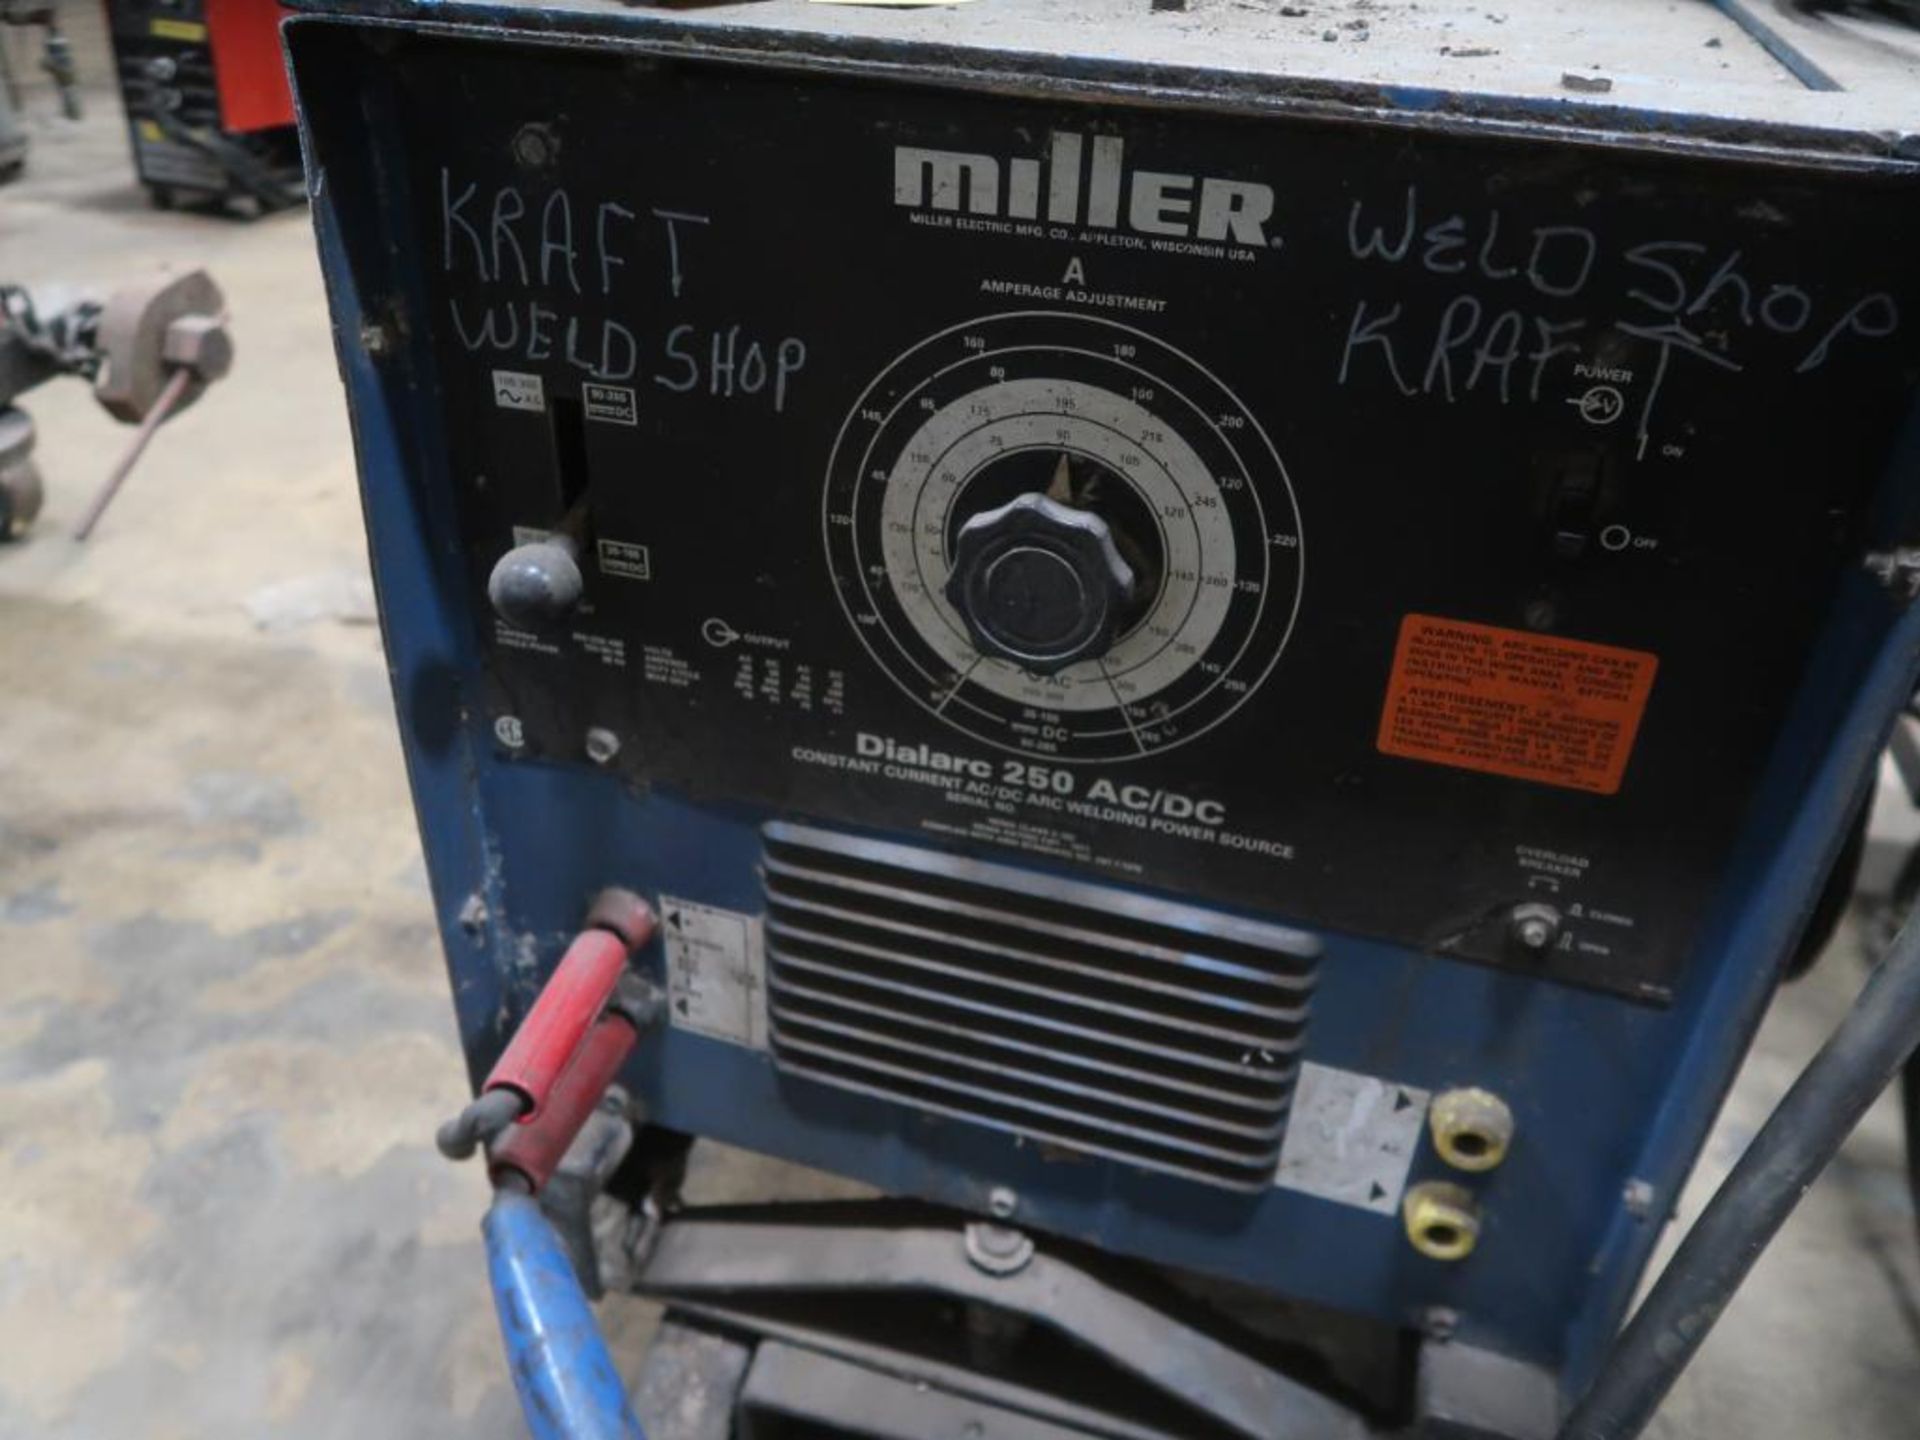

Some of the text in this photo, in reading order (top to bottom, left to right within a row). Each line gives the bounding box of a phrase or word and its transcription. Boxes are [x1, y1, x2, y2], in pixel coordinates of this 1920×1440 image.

[441, 166, 710, 297] KRAFT
[909, 211, 953, 229] MILLER
[956, 217, 1013, 235] ELECTRIC
[1151, 238, 1224, 260] WISCONSIN
[1228, 248, 1257, 263] USA
[1348, 185, 1595, 295] WELD
[1062, 256, 1086, 286] A
[980, 279, 1168, 313] AMPERAGE ADJUSTMENT
[449, 299, 807, 412] WELD SHOP
[1338, 296, 1744, 461] KRAFT
[1574, 363, 1634, 384] POWER
[1219, 477, 1243, 491] 120
[1273, 534, 1298, 548] 220
[743, 632, 790, 650] OUTPUT
[1041, 724, 1069, 742] DC
[855, 732, 1229, 827] Dialarc 250 AC/DC
[791, 745, 880, 777] CONSTANT
[883, 762, 963, 793] CURRENT
[964, 778, 1024, 804] AC/DC
[1025, 790, 1063, 812] ARC
[1066, 798, 1147, 830] WELDING
[1150, 815, 1217, 844] POWER
[1218, 830, 1295, 861] SOURCE
[1515, 844, 1590, 869] OVERLOAD
[1518, 857, 1581, 878] BREAKER
